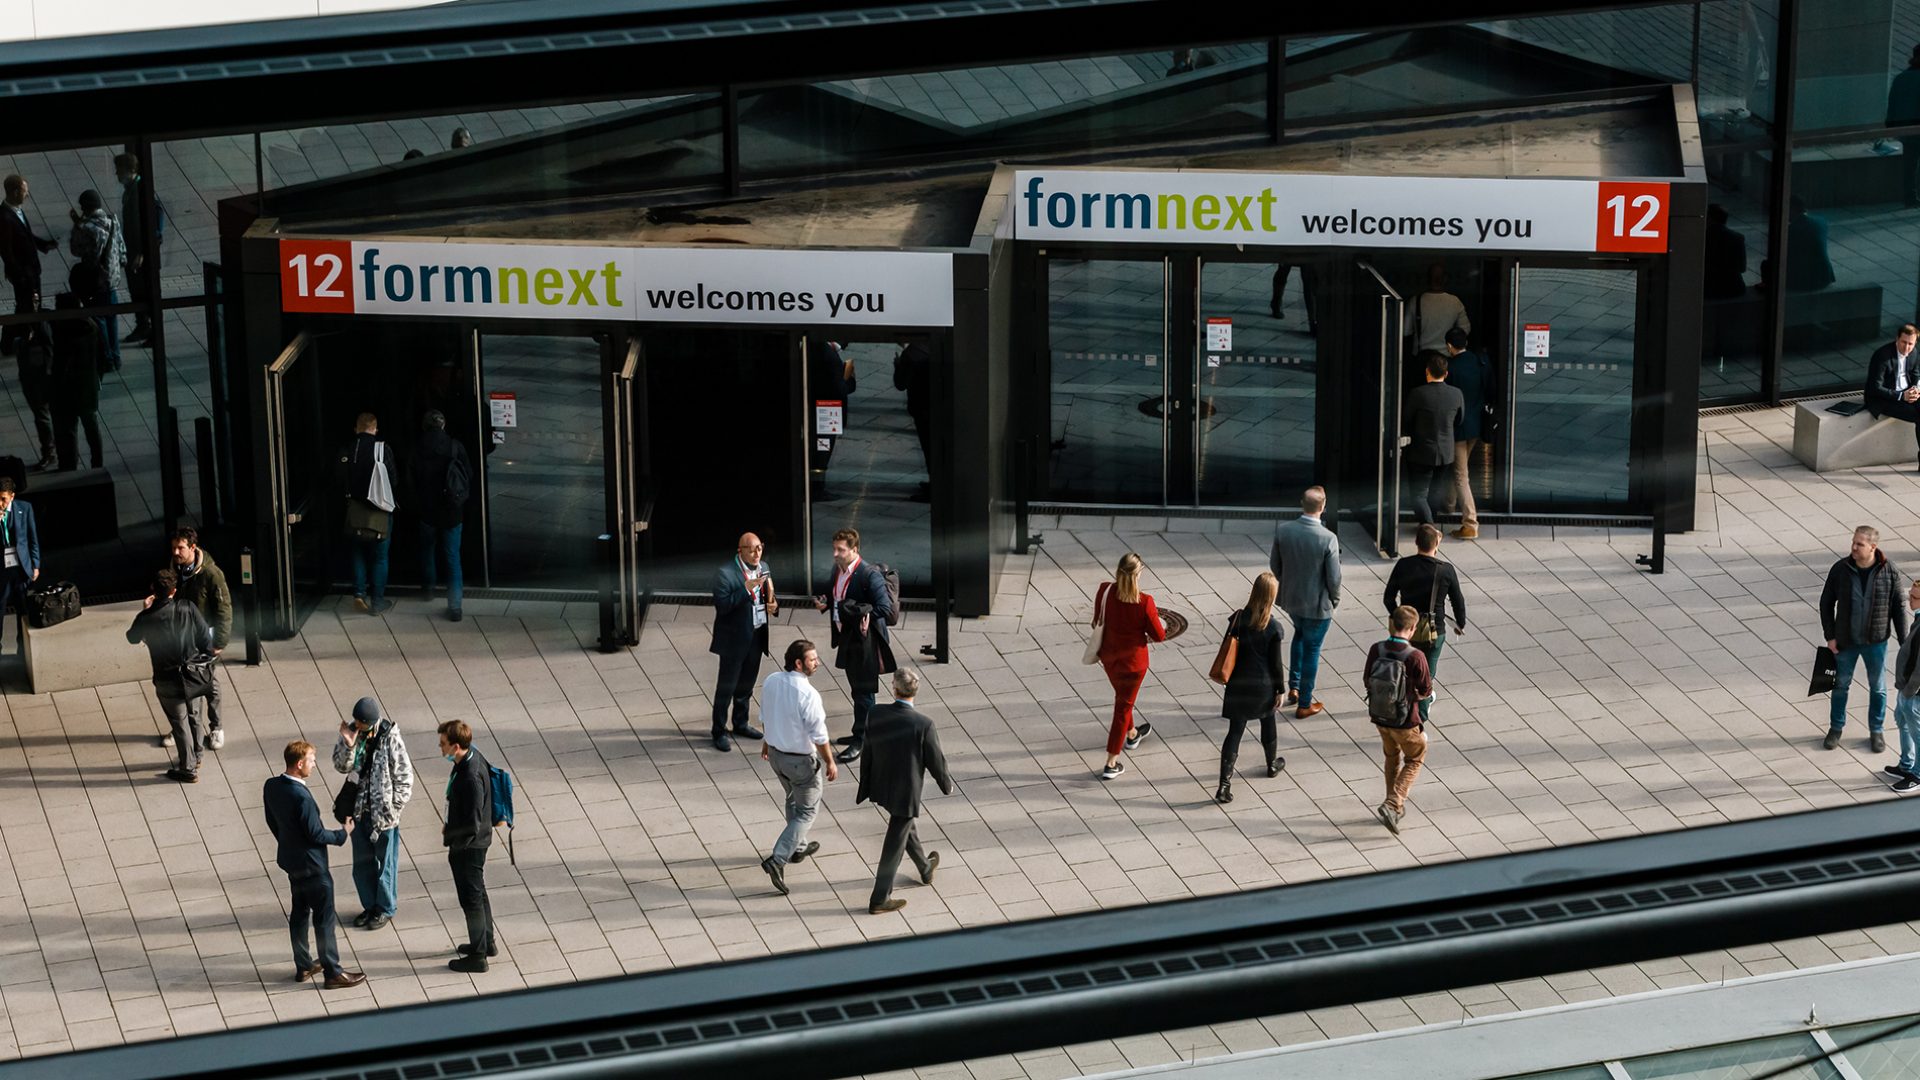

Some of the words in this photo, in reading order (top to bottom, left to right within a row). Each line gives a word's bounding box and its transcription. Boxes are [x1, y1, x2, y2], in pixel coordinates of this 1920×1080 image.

[1023, 176, 1278, 232] formnext
[1301, 208, 1464, 237] welcomes
[1474, 218, 1532, 244] you
[1607, 194, 1660, 238] 12
[288, 253, 345, 298] 12
[359, 248, 623, 307] formnext
[645, 282, 815, 312] welcomes
[825, 292, 885, 319] you
